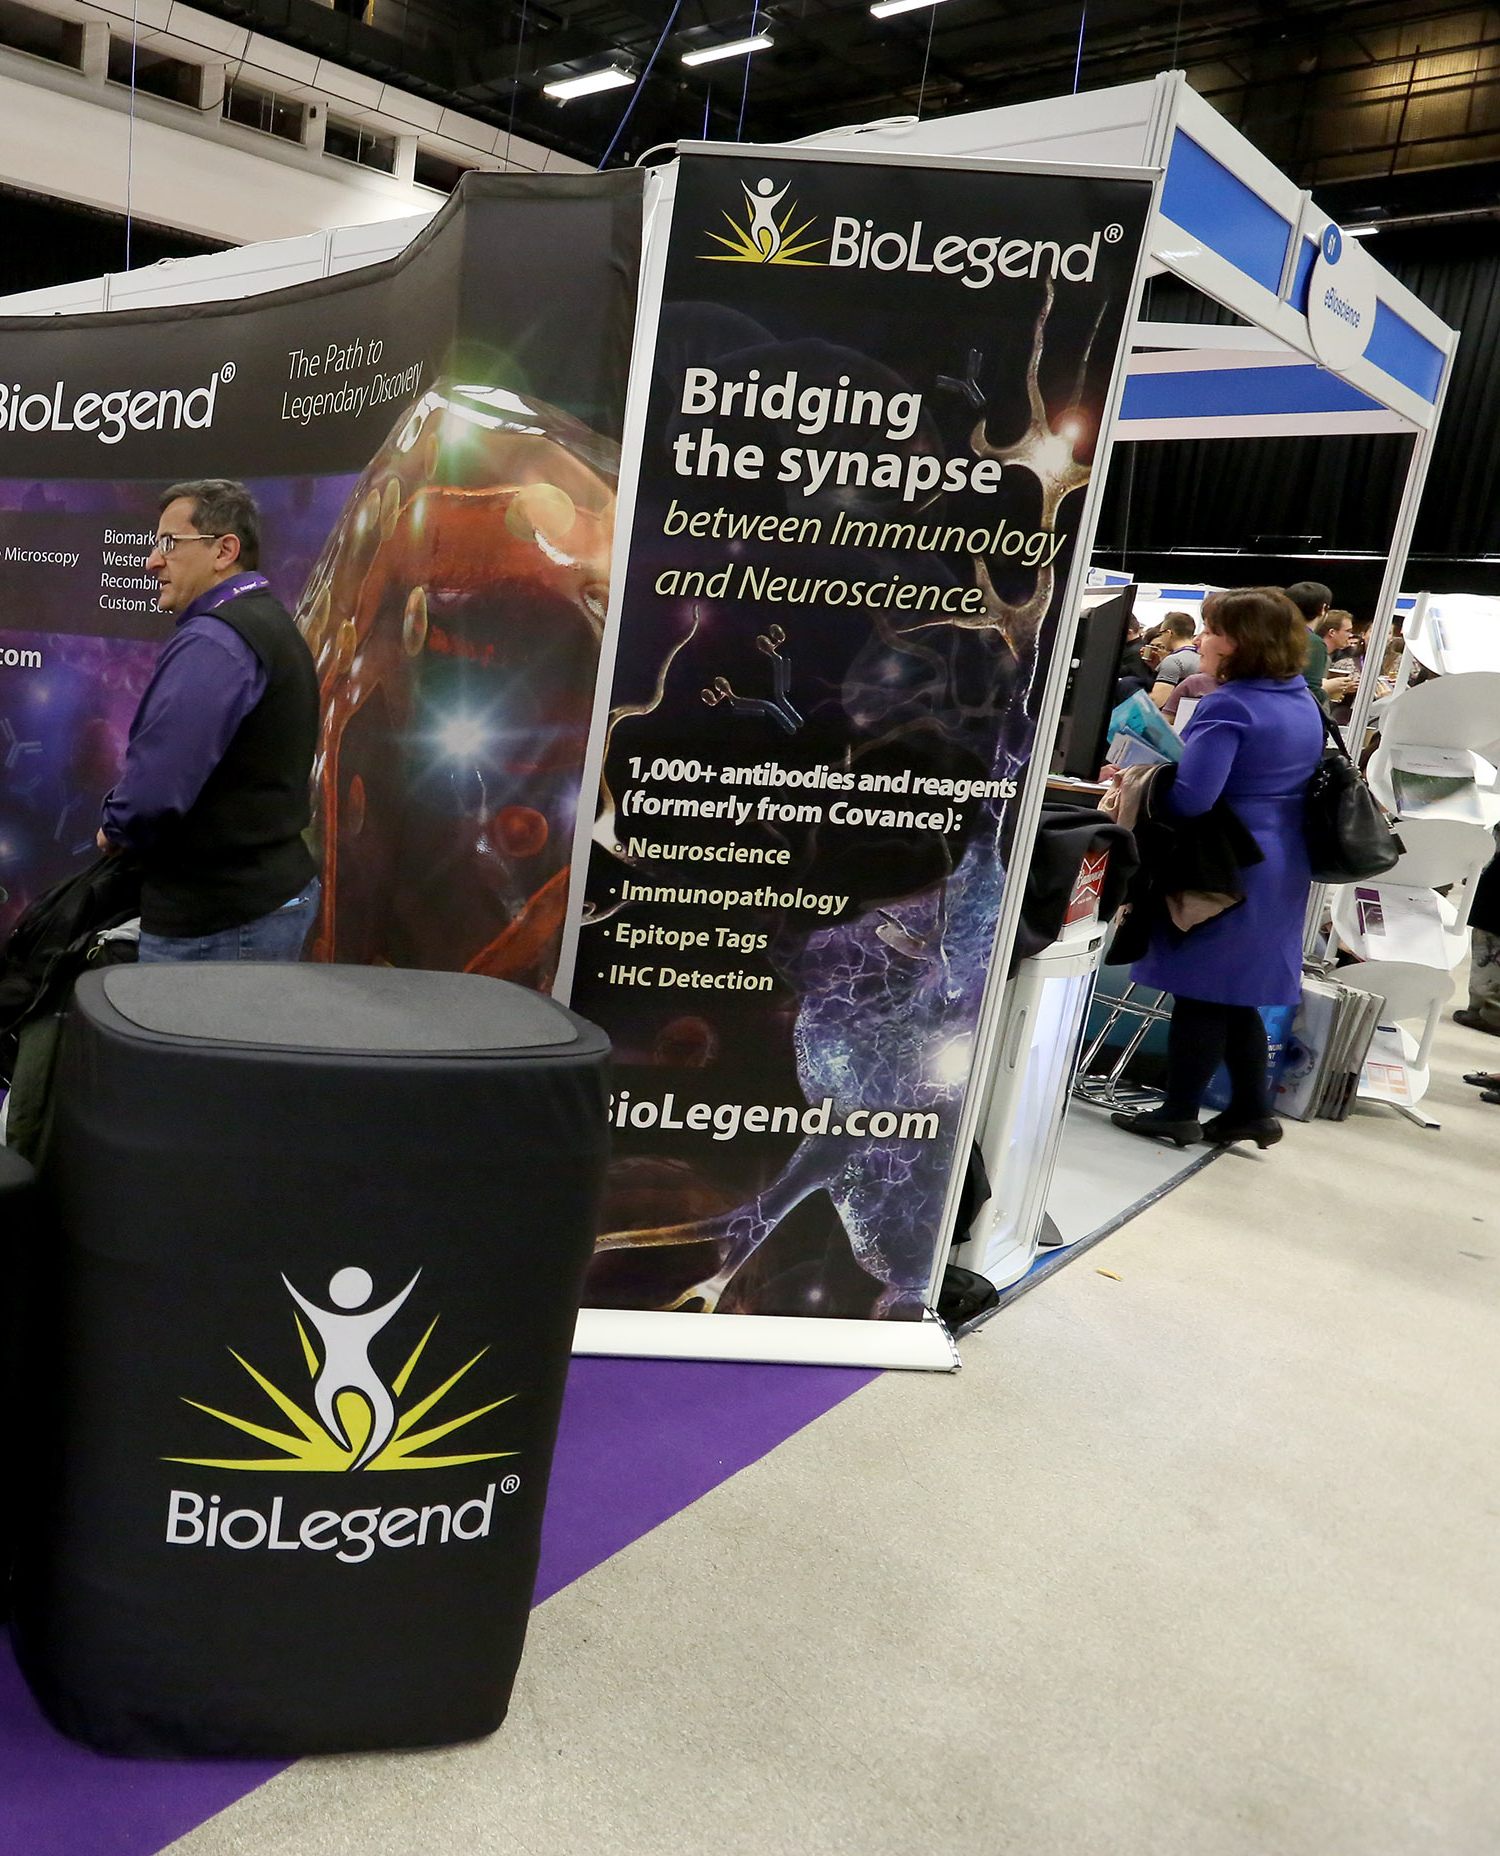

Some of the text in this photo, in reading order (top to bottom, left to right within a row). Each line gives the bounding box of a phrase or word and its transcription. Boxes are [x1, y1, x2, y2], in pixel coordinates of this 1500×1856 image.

[1324, 286, 1361, 328] eBioscience
[288, 337, 384, 380] The Path to
[281, 360, 424, 426] Legendary Discovery
[680, 367, 923, 441] Bridging
[672, 428, 1003, 502] the synapse
[662, 499, 1067, 568] between Immunology
[4, 547, 80, 567] Microscopy
[99, 594, 146, 611] Custom
[654, 564, 989, 614] and Neuroscience.
[628, 757, 1018, 803] 1,000+ antibodies and reagents
[621, 789, 964, 835] (formerly from Covance):
[627, 837, 791, 865] Neuroscience
[621, 880, 850, 916] Immunopathology
[615, 923, 768, 952] Epitope Tags
[609, 965, 775, 992] IHC Detection
